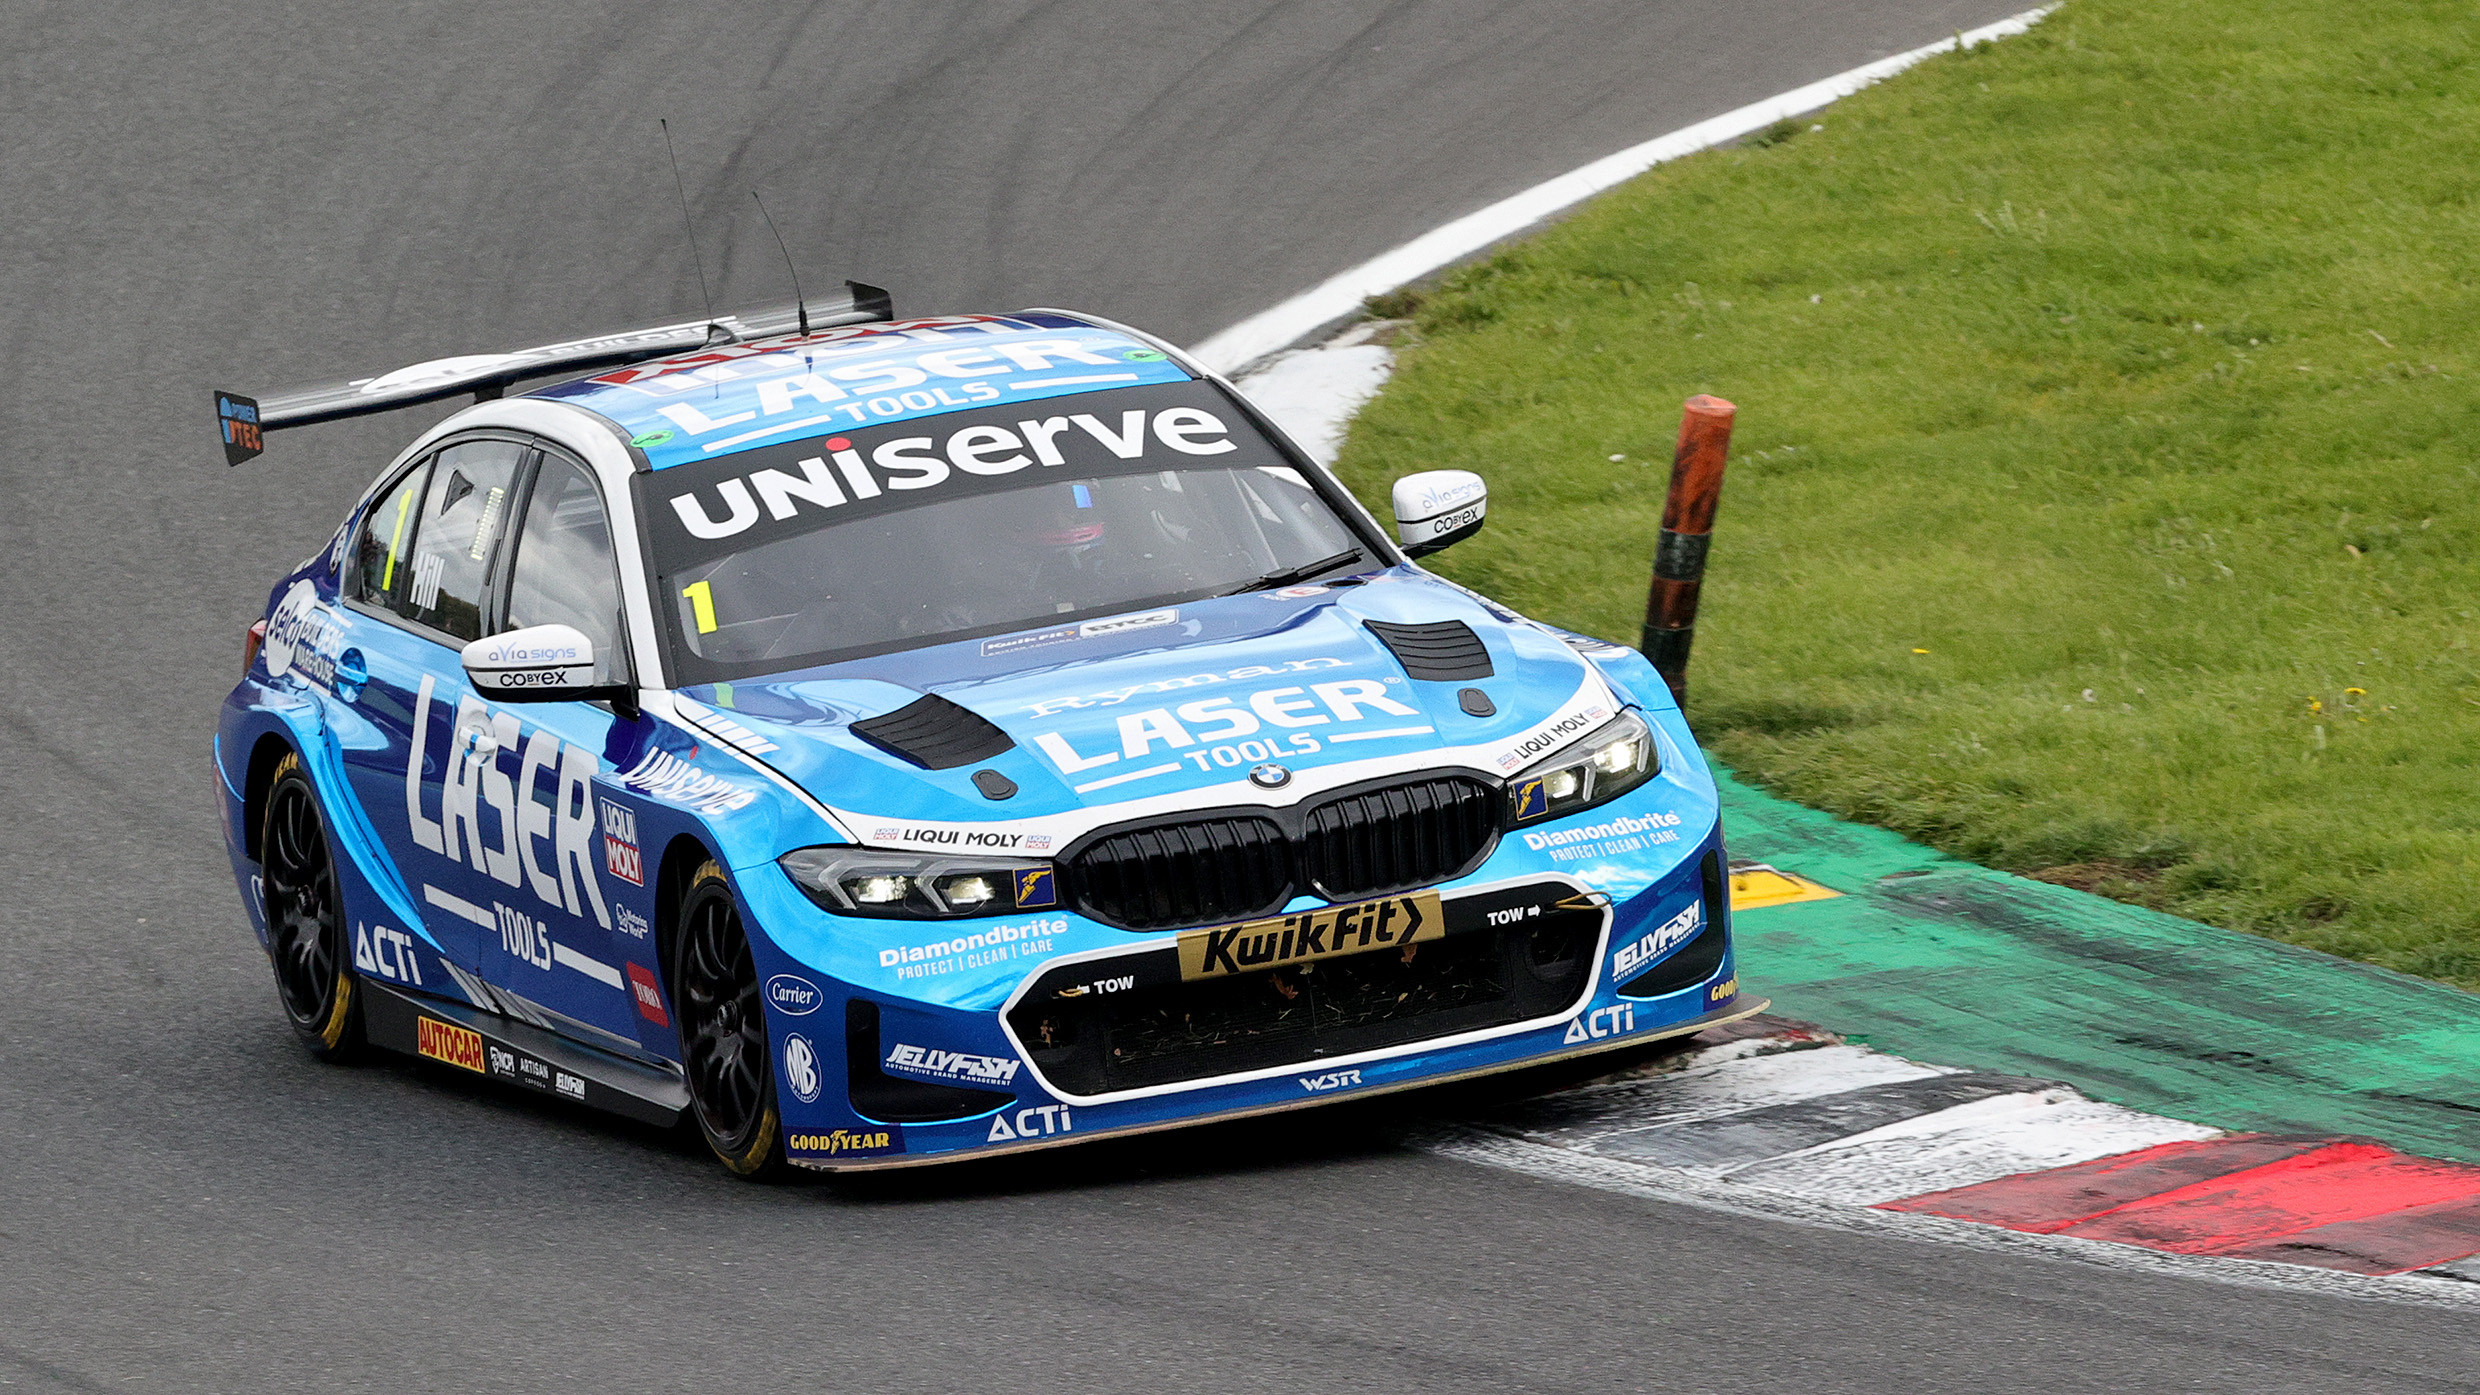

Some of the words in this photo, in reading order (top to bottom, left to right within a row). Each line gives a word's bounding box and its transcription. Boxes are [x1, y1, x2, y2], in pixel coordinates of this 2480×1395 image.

[656, 339, 1123, 436] LASER
[835, 381, 1001, 422] TOOLS
[382, 489, 413, 591] 1
[410, 551, 445, 611] Hill
[682, 580, 718, 634] 1
[530, 648, 577, 661] signs
[1018, 657, 1352, 719] Ryman
[1033, 679, 1420, 775] LASER
[1513, 732, 1556, 759] LIQUI
[1550, 712, 1590, 738] MOLY
[1183, 732, 1322, 772] TOOLS
[406, 673, 613, 930] LASER
[602, 802, 637, 845] LIQUI
[903, 828, 959, 844] LIQUI
[965, 832, 1023, 848] MOLY
[1523, 811, 1682, 851] Diamondbrite
[605, 837, 641, 882] MOLY
[1549, 843, 1598, 862] PROTECT
[1606, 836, 1643, 857] CLEAN
[1649, 828, 1681, 846] CARE
[493, 900, 551, 971] TOOLS
[1487, 907, 1525, 926] TOW
[878, 919, 1069, 968] Diamondbrite
[1612, 899, 1699, 977] JELLYFISH
[898, 958, 953, 980] PROTECT
[968, 947, 1008, 969] CLEAN
[1022, 939, 1053, 956] CARE
[772, 982, 814, 1004] Carrier
[1094, 975, 1134, 996] TOW
[418, 1019, 484, 1072] AUTOCAR
[886, 1043, 1020, 1081] JELLYFISH
[885, 1062, 931, 1075] AUTOMOTIVE
[933, 1070, 958, 1079] BRAND
[960, 1074, 1011, 1086] MANAGEMENT
[1299, 1069, 1362, 1092] WSR
[790, 1129, 890, 1154] GOODYEAR
